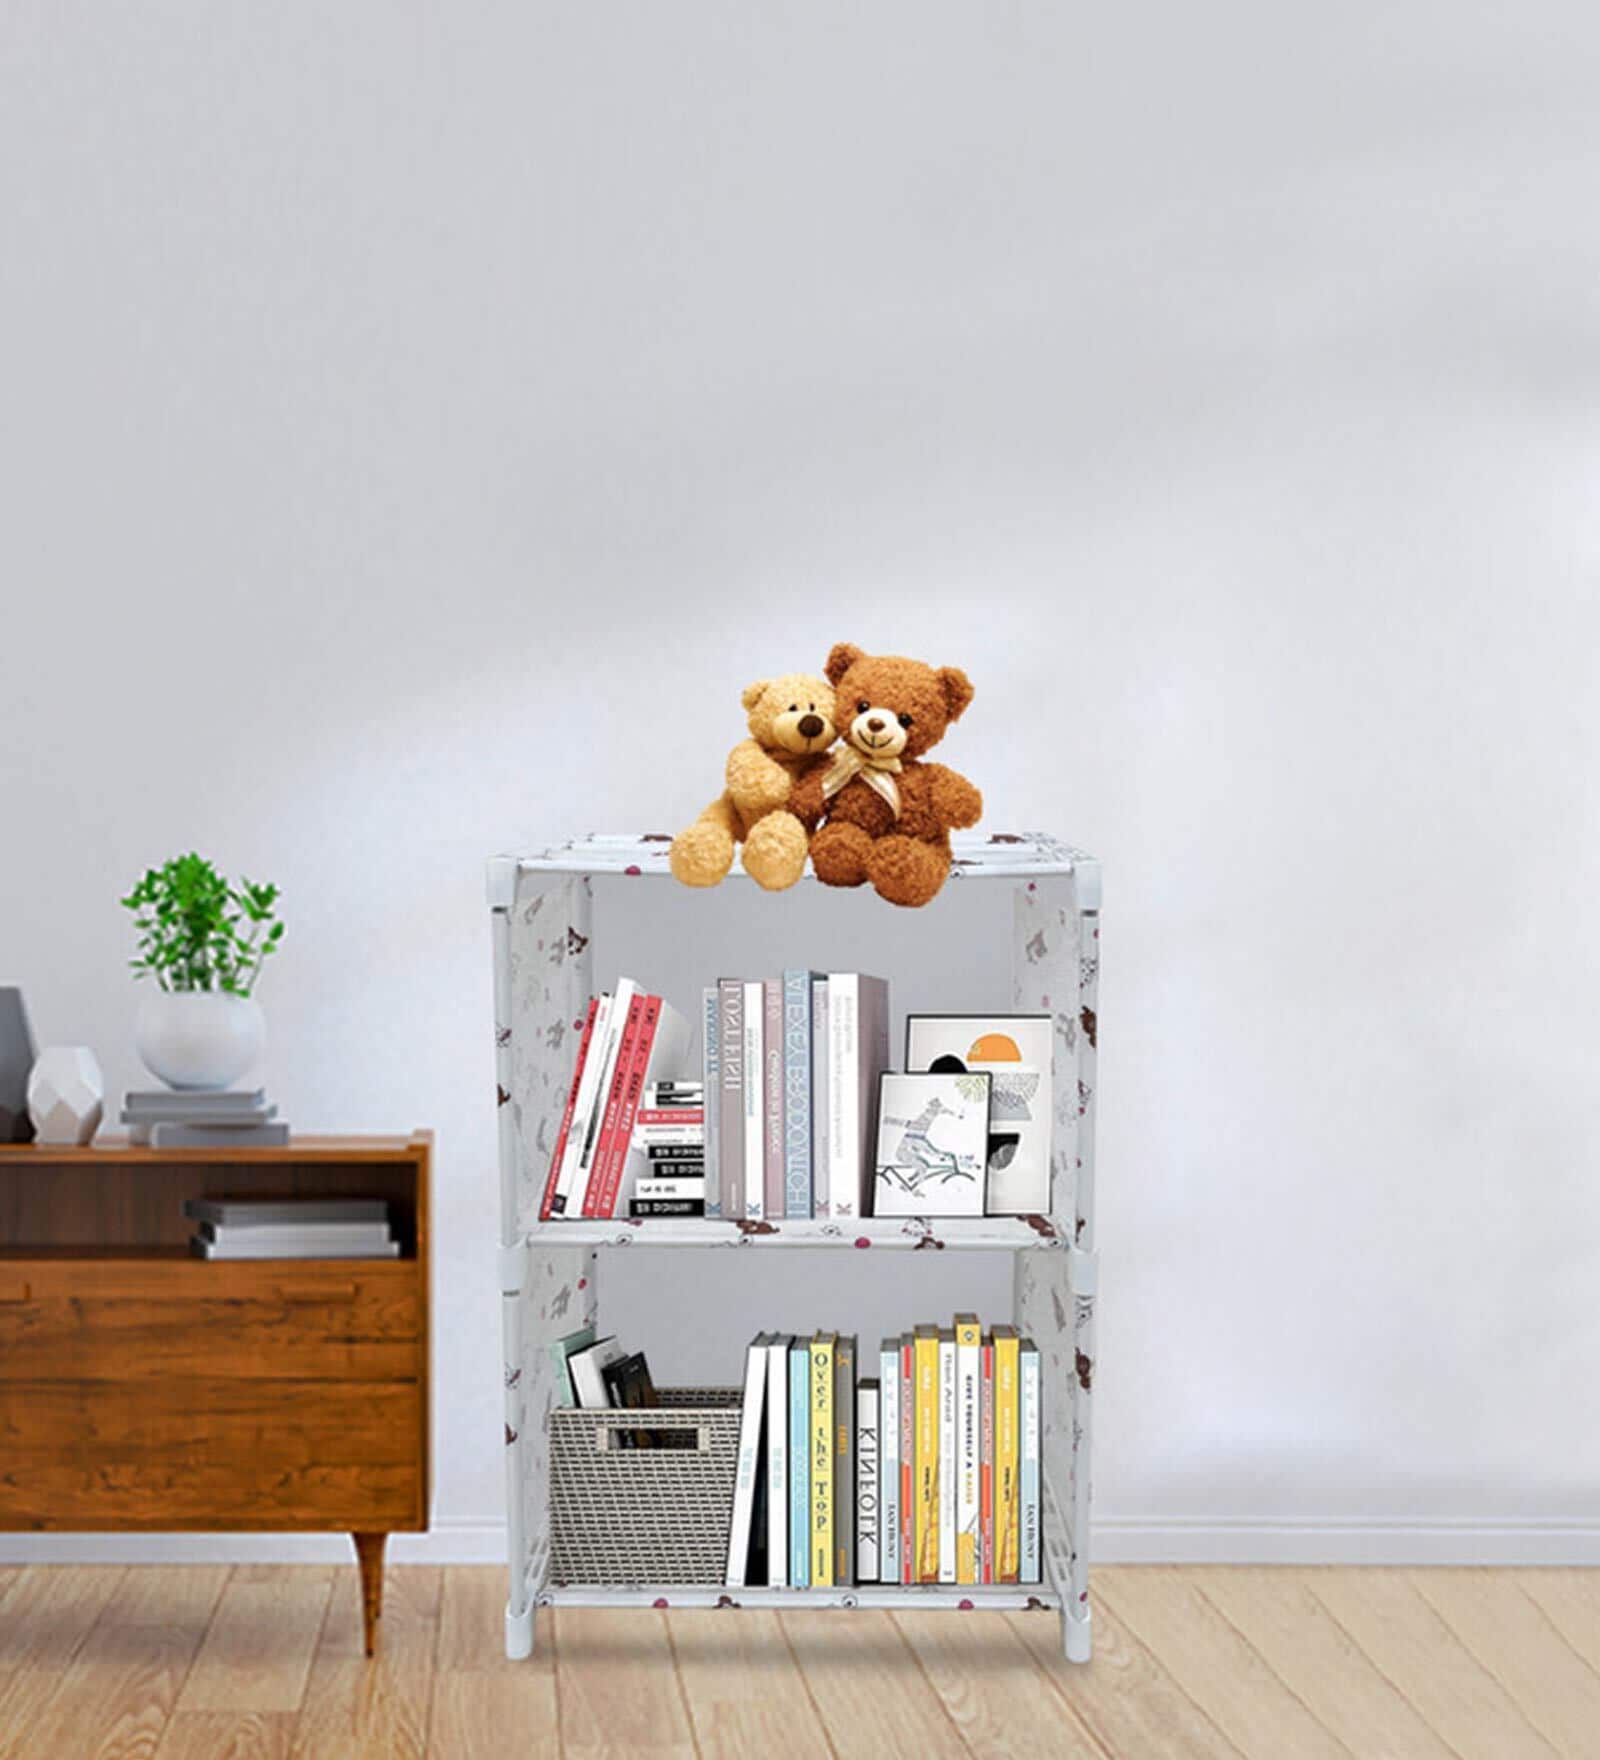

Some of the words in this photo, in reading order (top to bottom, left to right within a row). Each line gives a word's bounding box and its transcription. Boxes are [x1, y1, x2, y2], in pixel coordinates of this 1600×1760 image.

[814, 1353, 829, 1408] Over
[965, 1375, 973, 1399] GIVE
[815, 1426, 828, 1467] the
[965, 1404, 973, 1458] YOURSELF
